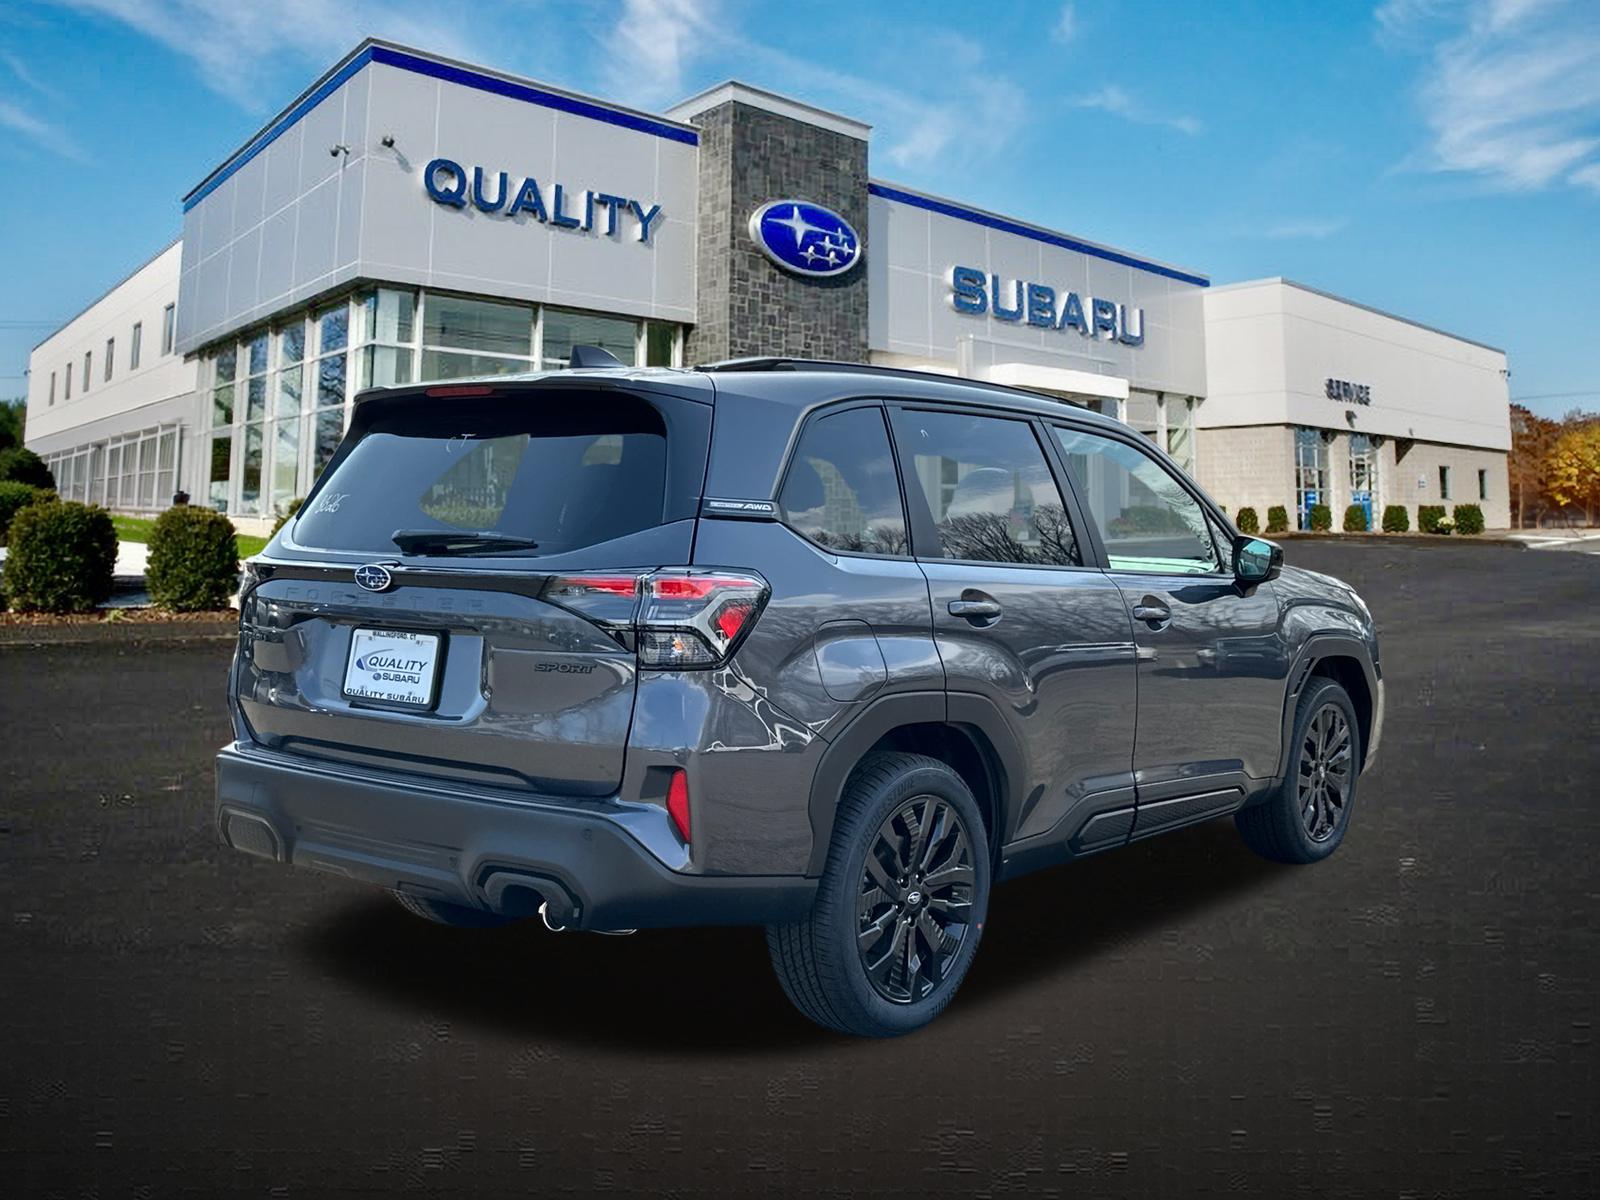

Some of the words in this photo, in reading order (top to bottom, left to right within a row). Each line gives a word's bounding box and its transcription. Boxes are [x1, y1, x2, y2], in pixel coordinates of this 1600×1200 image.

[423, 157, 662, 243] QUALITY
[951, 265, 1145, 347] SUBARU
[1325, 378, 1371, 406] SERVICE
[743, 503, 772, 511] AWD
[410, 632, 417, 641] CT
[369, 656, 428, 672] QUALITY
[534, 662, 598, 674] SPORT
[382, 673, 420, 684] SUBARU
[346, 687, 385, 698] QUALITY
[386, 692, 425, 704] SUBARU
